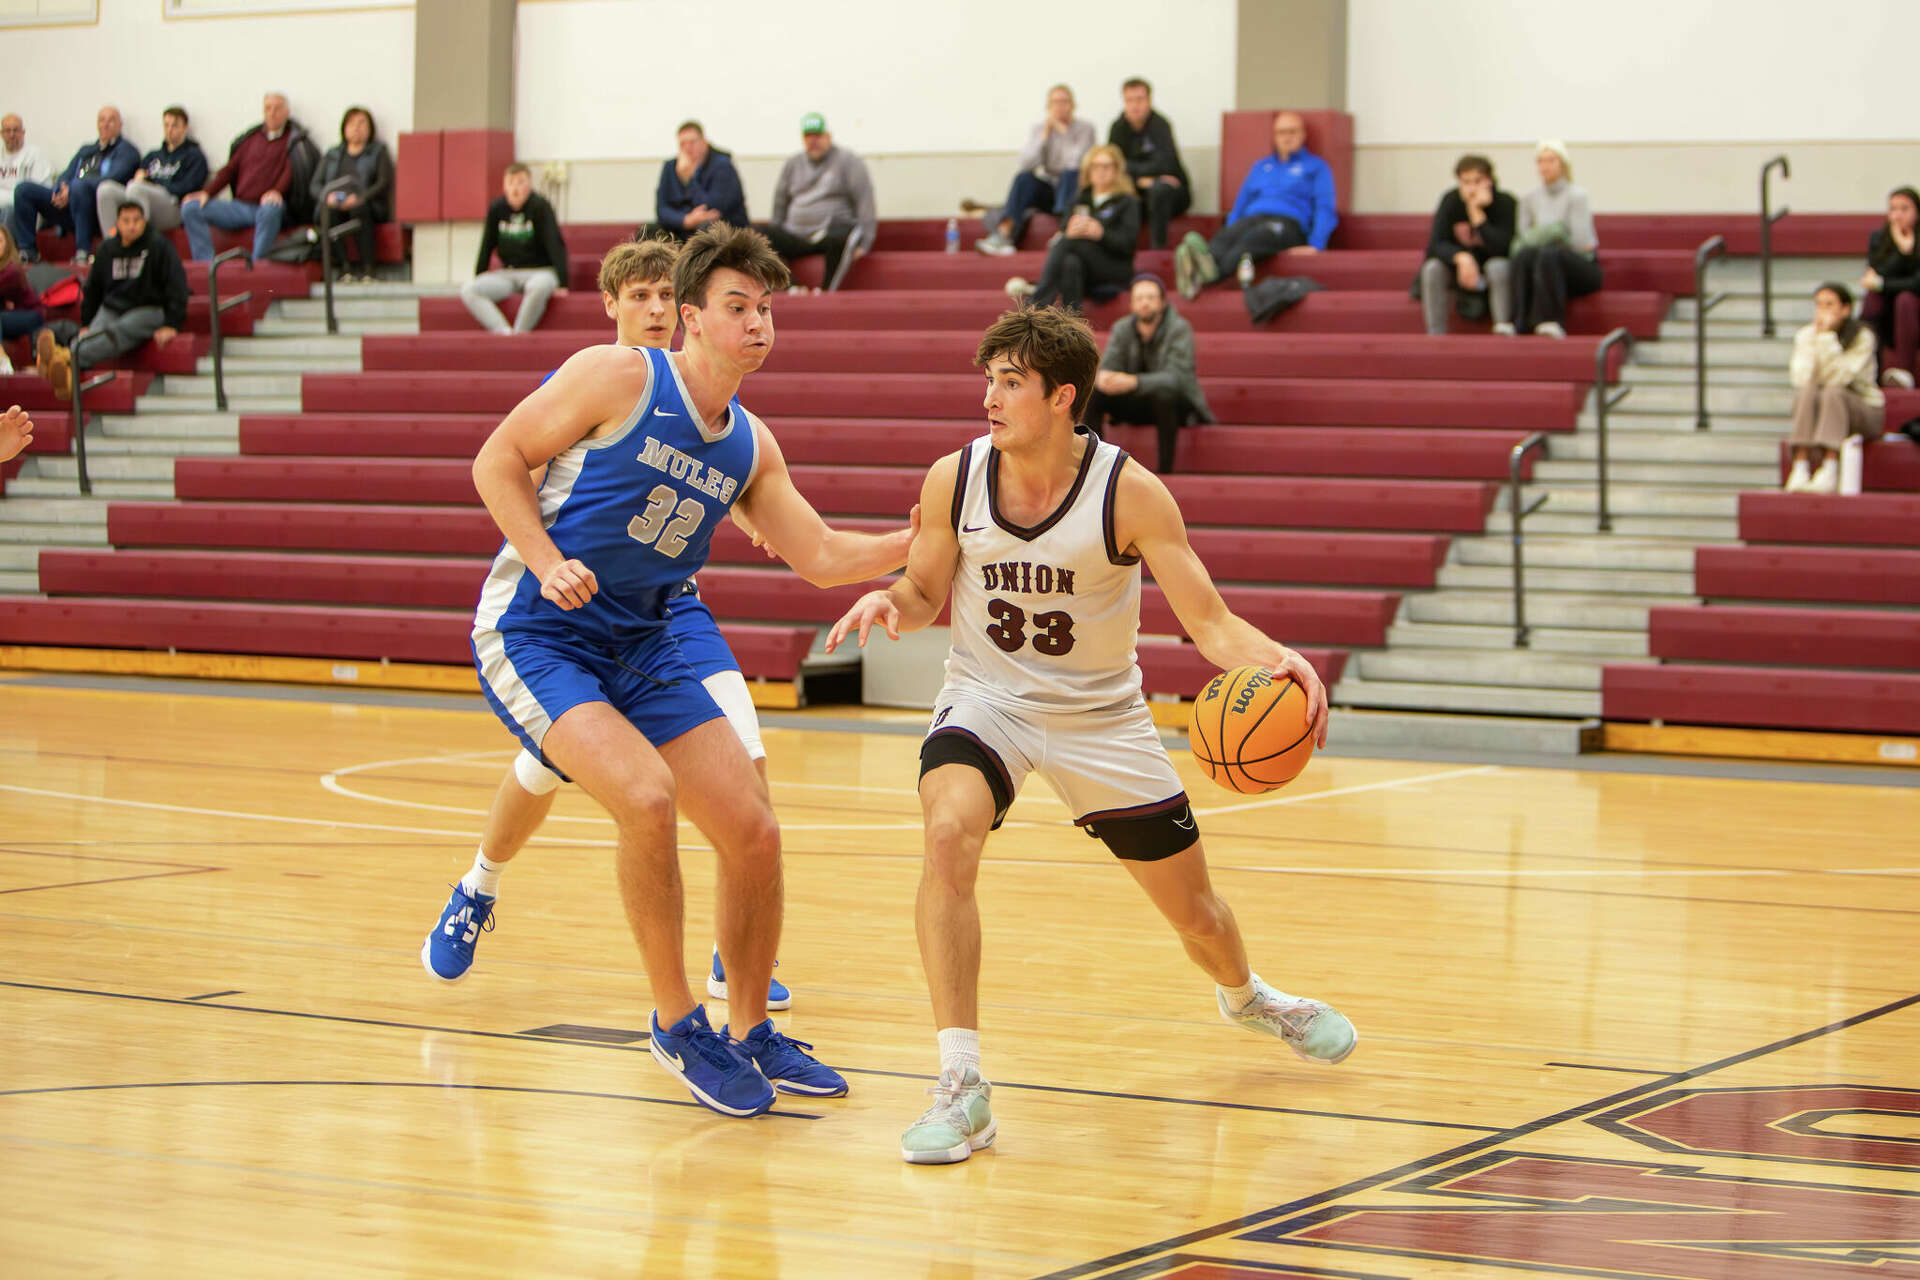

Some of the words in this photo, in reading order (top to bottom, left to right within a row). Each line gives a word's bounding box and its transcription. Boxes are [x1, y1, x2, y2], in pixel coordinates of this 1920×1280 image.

[636, 435, 738, 505] MULES
[627, 484, 706, 559] 32
[981, 561, 1076, 596] UNION
[985, 598, 1076, 656] 33
